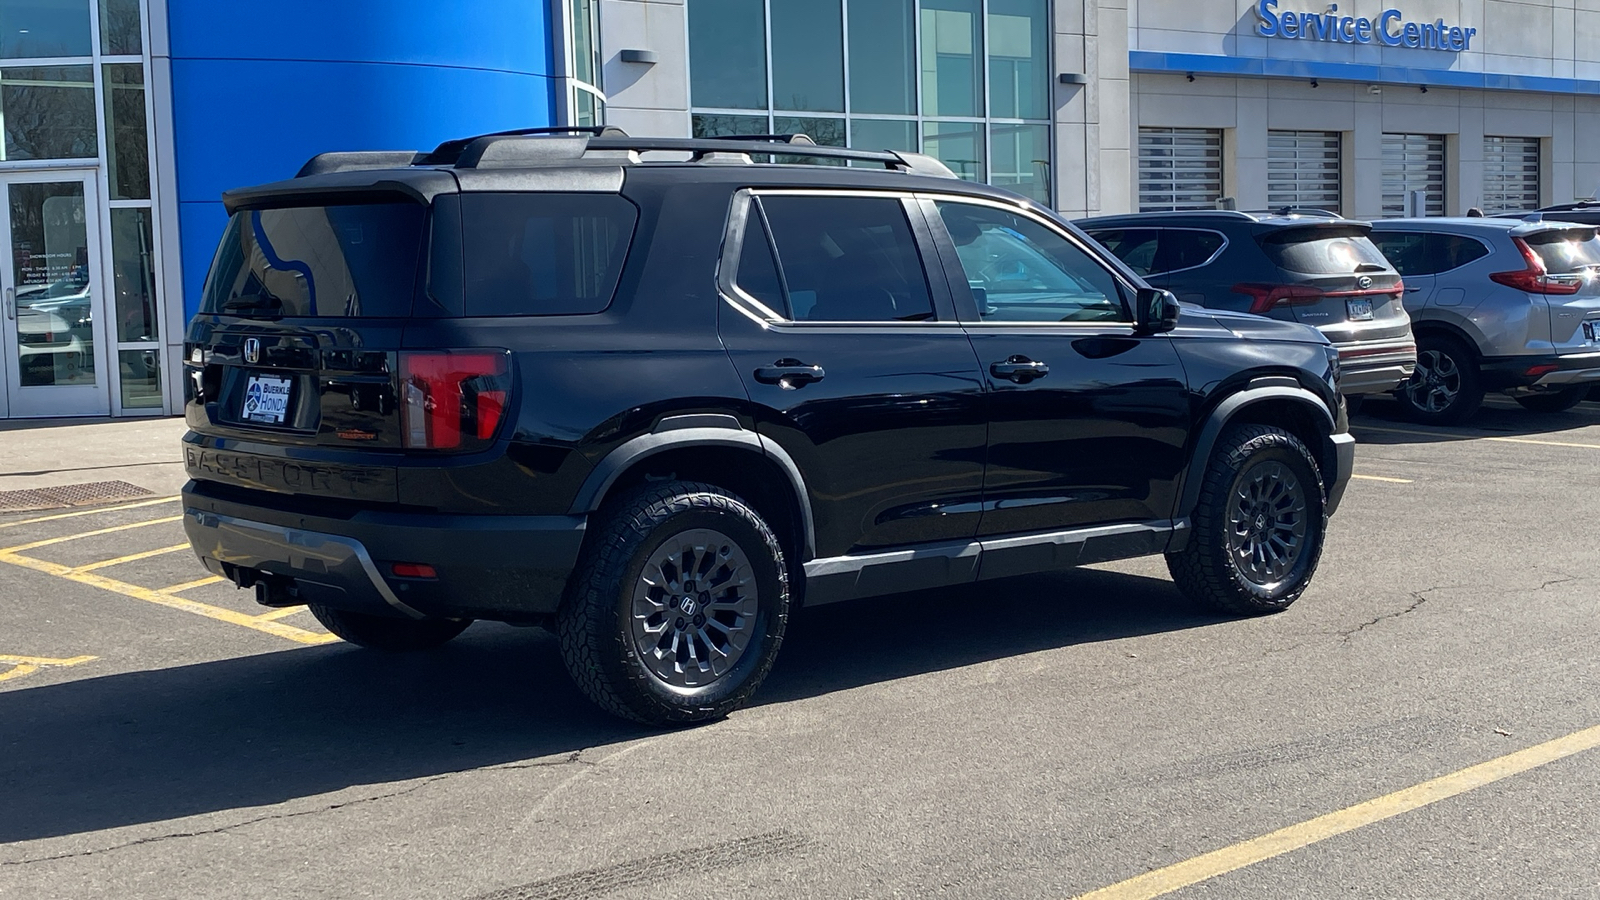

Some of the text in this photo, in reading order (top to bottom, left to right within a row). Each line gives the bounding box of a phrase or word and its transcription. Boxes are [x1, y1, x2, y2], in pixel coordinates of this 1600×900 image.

[1256, 0, 1477, 51] Service Center
[260, 393, 287, 412] HONDA
